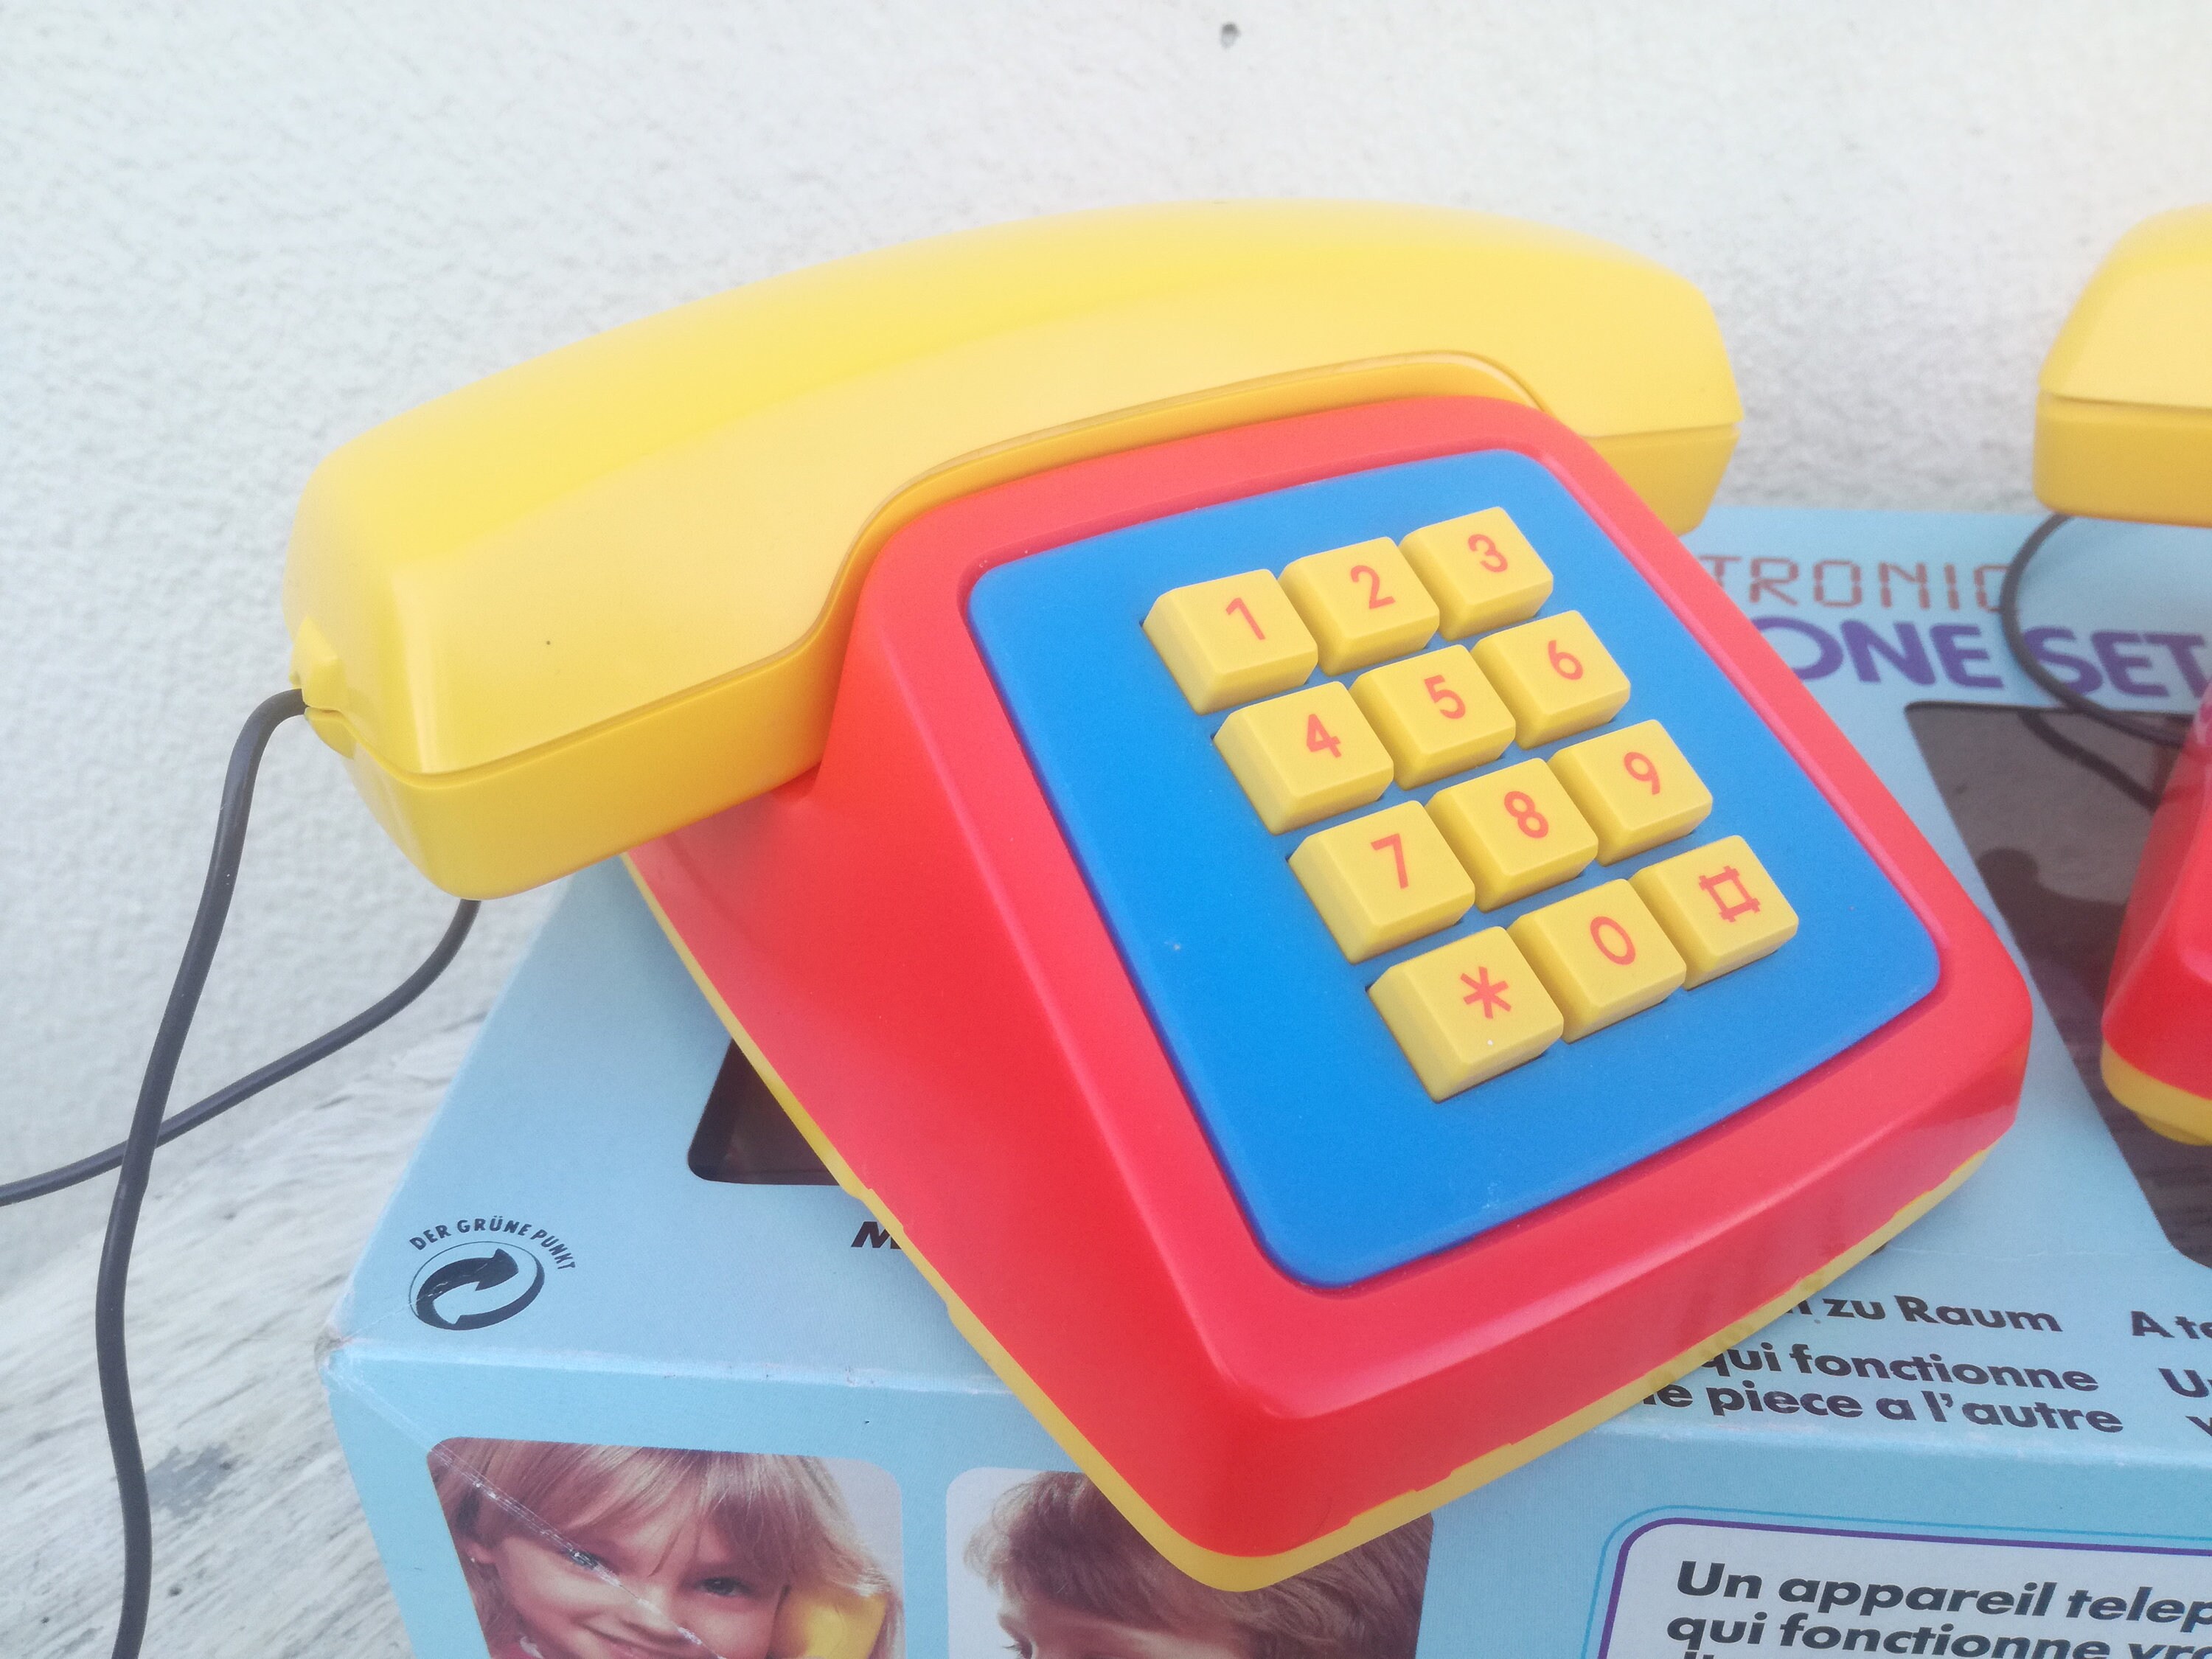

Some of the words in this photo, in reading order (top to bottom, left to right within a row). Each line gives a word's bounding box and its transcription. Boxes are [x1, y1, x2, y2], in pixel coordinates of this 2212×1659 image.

[1225, 597, 1266, 641] 1
[1350, 565, 1394, 610] 2
[1468, 533, 1509, 573] 3
[2023, 625, 2205, 698] SET
[1305, 714, 1341, 759] 4
[1425, 674, 1467, 720] 5
[1547, 640, 1584, 681] 6
[1371, 833, 1409, 889] 7
[1503, 790, 1549, 839] 8
[1624, 751, 1661, 796] 9
[1590, 916, 1636, 966] 0
[409, 1225, 452, 1251] DER
[456, 1215, 532, 1236] GRÜNE
[530, 1229, 576, 1270] PUNKT
[1822, 1298, 1886, 1320] zu
[1893, 1295, 2063, 1332] Raum
[2130, 1310, 2175, 1338] A
[1790, 1343, 2099, 1392] fonctionne
[2157, 1367, 2212, 1398] U
[1643, 1384, 1694, 1408] e
[1705, 1380, 1863, 1418] piece
[1877, 1397, 1917, 1421] a
[1677, 1560, 1763, 1599] Un
[1778, 1578, 2058, 1616] appareil
[2066, 1586, 2212, 1632] telep
[1666, 1611, 1768, 1651] qui
[1779, 1612, 2110, 1659] fonctionne
